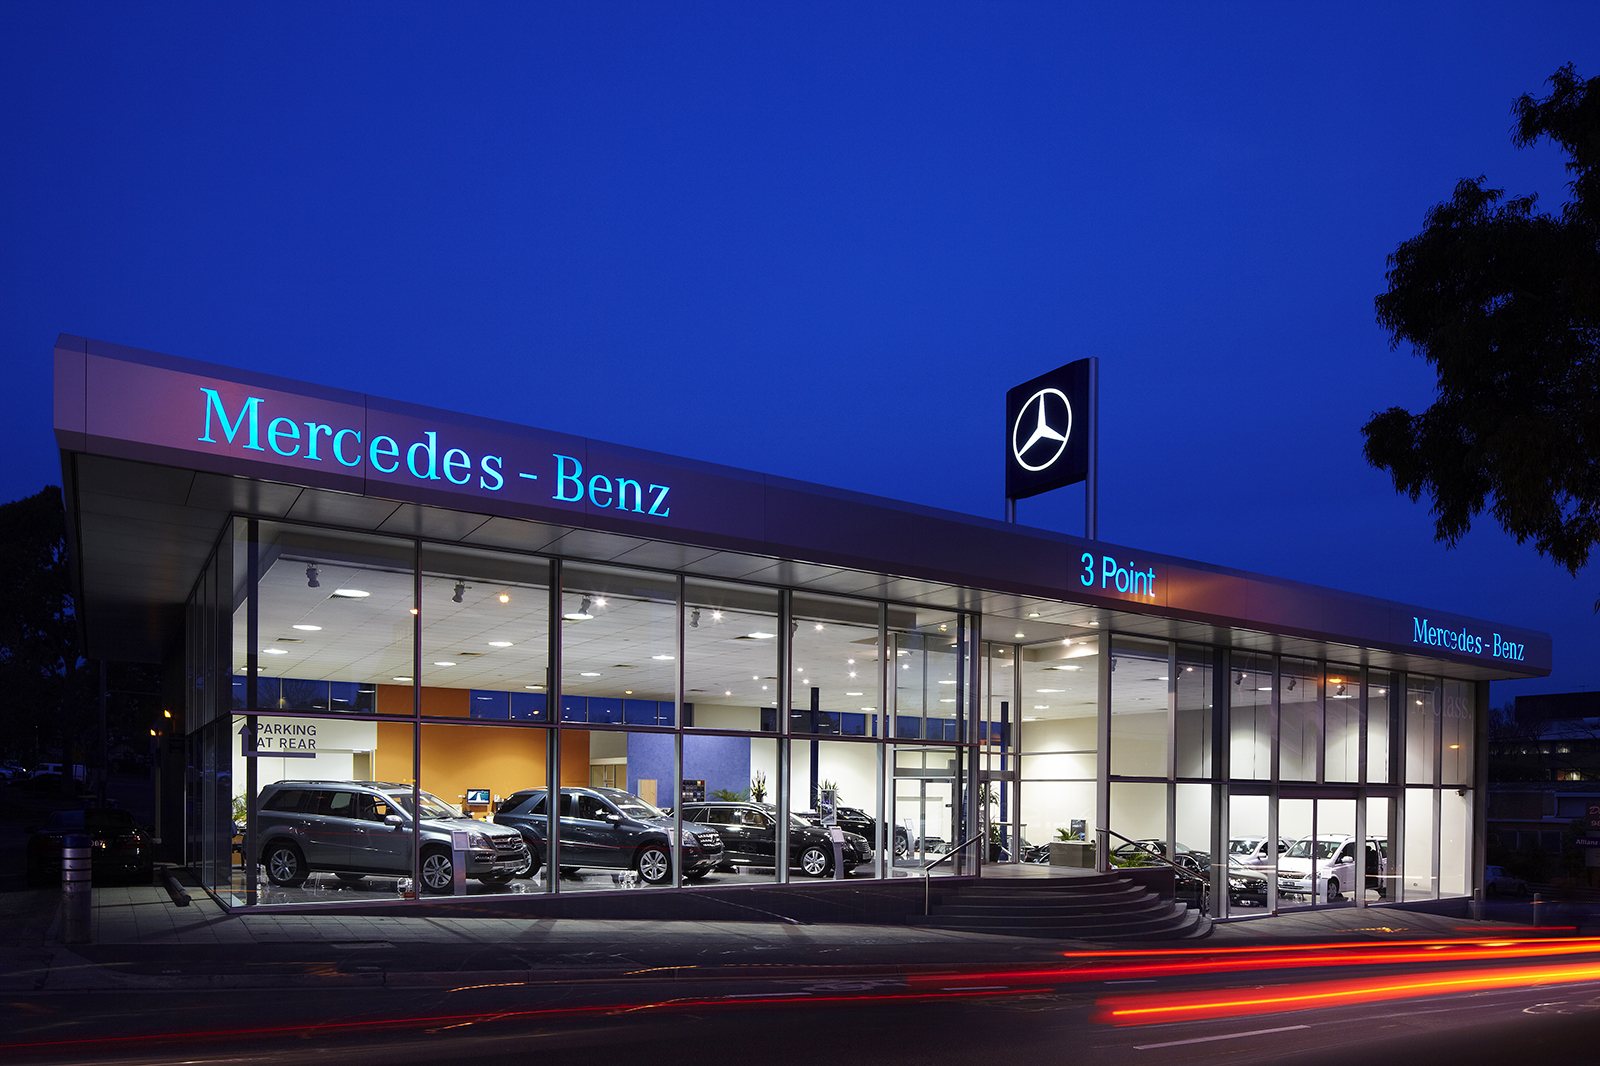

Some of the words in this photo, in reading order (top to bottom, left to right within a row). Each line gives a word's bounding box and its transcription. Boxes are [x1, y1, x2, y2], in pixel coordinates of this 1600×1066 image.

[198, 387, 505, 491] Mercedes
[552, 453, 671, 518] Benz
[1081, 552, 1095, 587] 3
[1102, 555, 1156, 598] Point
[1413, 616, 1482, 655] Mercedes
[1492, 632, 1525, 661] Benz
[256, 723, 317, 736] PARKING
[256, 737, 273, 748] AT
[279, 737, 316, 749] REAR
